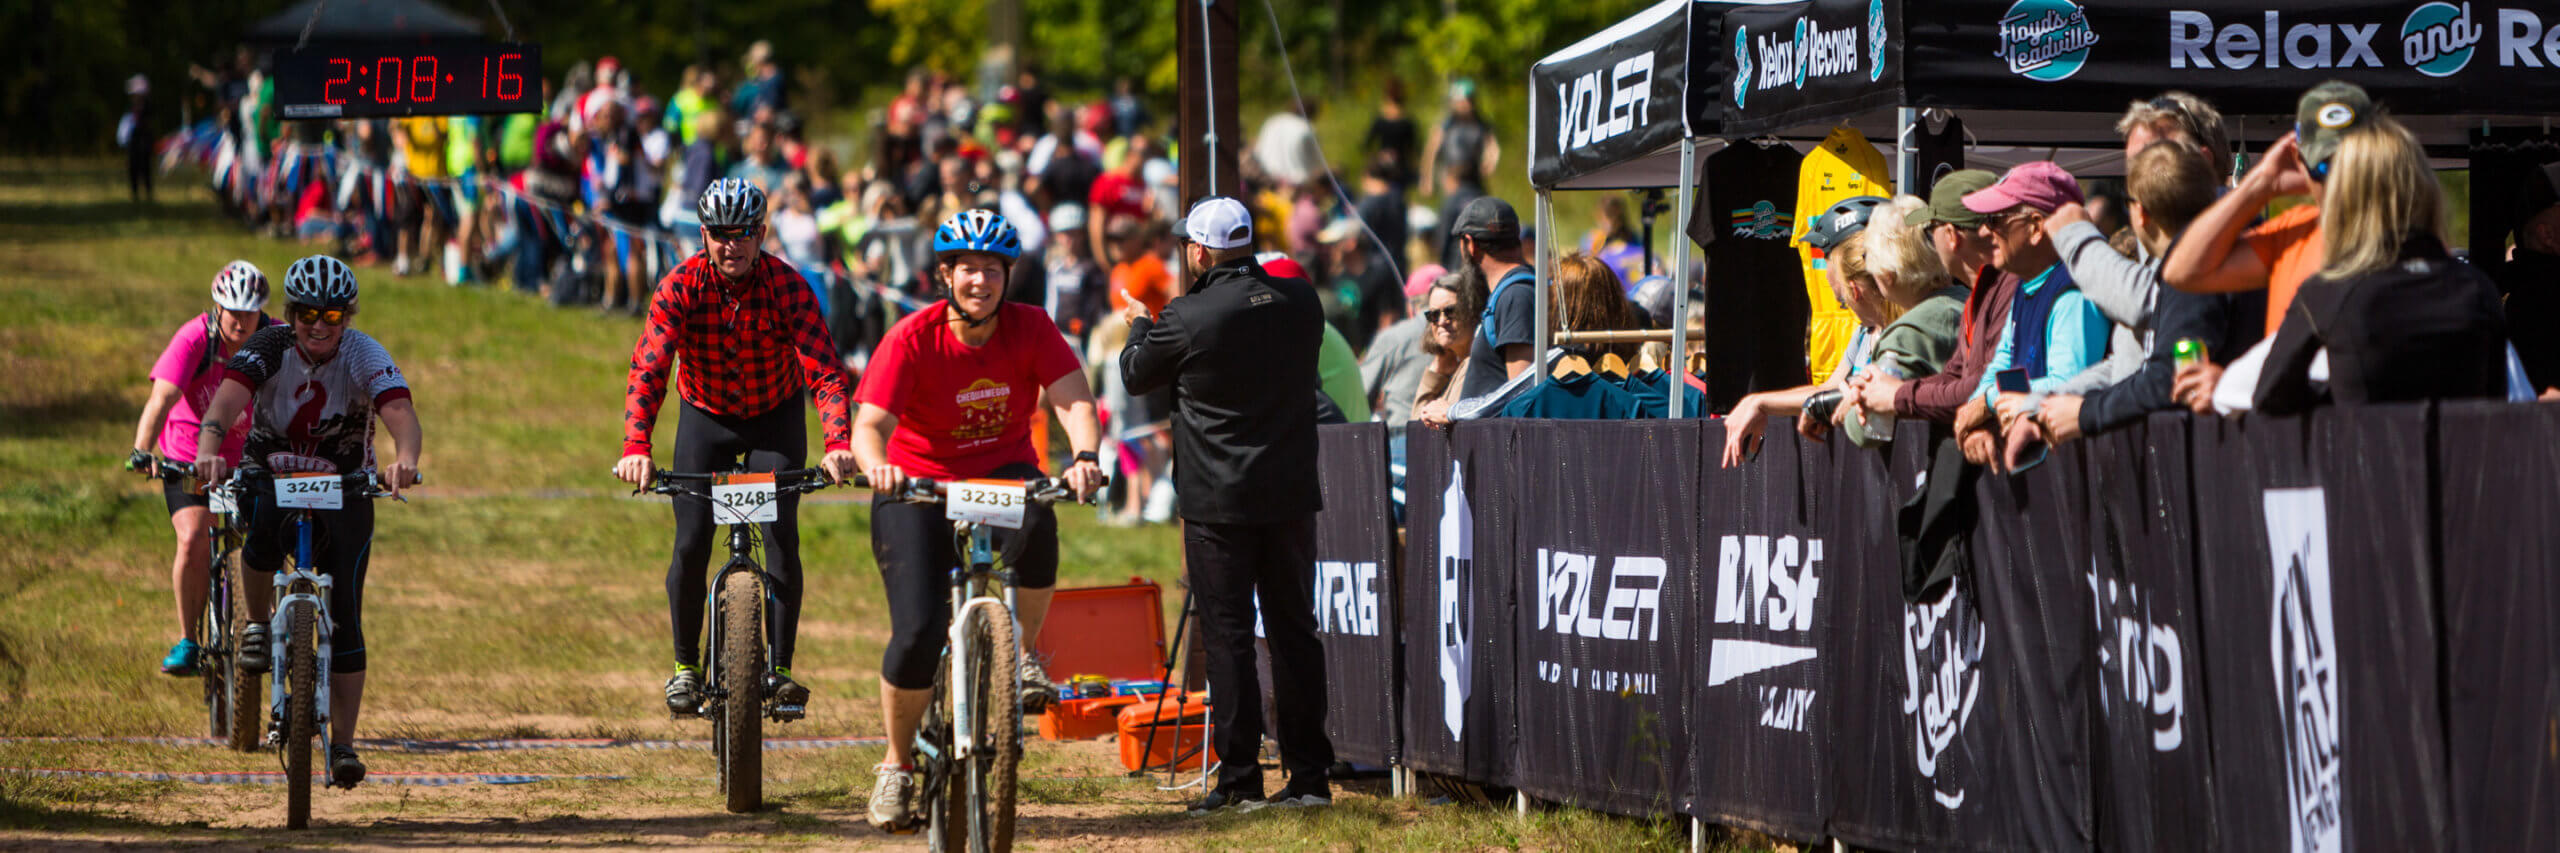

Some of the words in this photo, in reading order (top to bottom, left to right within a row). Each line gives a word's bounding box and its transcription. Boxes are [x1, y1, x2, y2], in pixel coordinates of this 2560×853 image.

[1758, 32, 1793, 90] Relax
[1808, 20, 1858, 77] Recover
[1993, 10, 2068, 57] Floyd's
[2071, 4, 2085, 24] of
[2010, 26, 2100, 74] Leadville
[2170, 10, 2385, 70] Relax
[2404, 1, 2482, 66] and
[1558, 51, 1655, 154] VOLER
[1834, 211, 1859, 233] FOX
[286, 480, 331, 494] 3247
[723, 490, 766, 508] 3248
[961, 488, 1012, 507] 3233
[1538, 548, 1667, 641] VOLER
